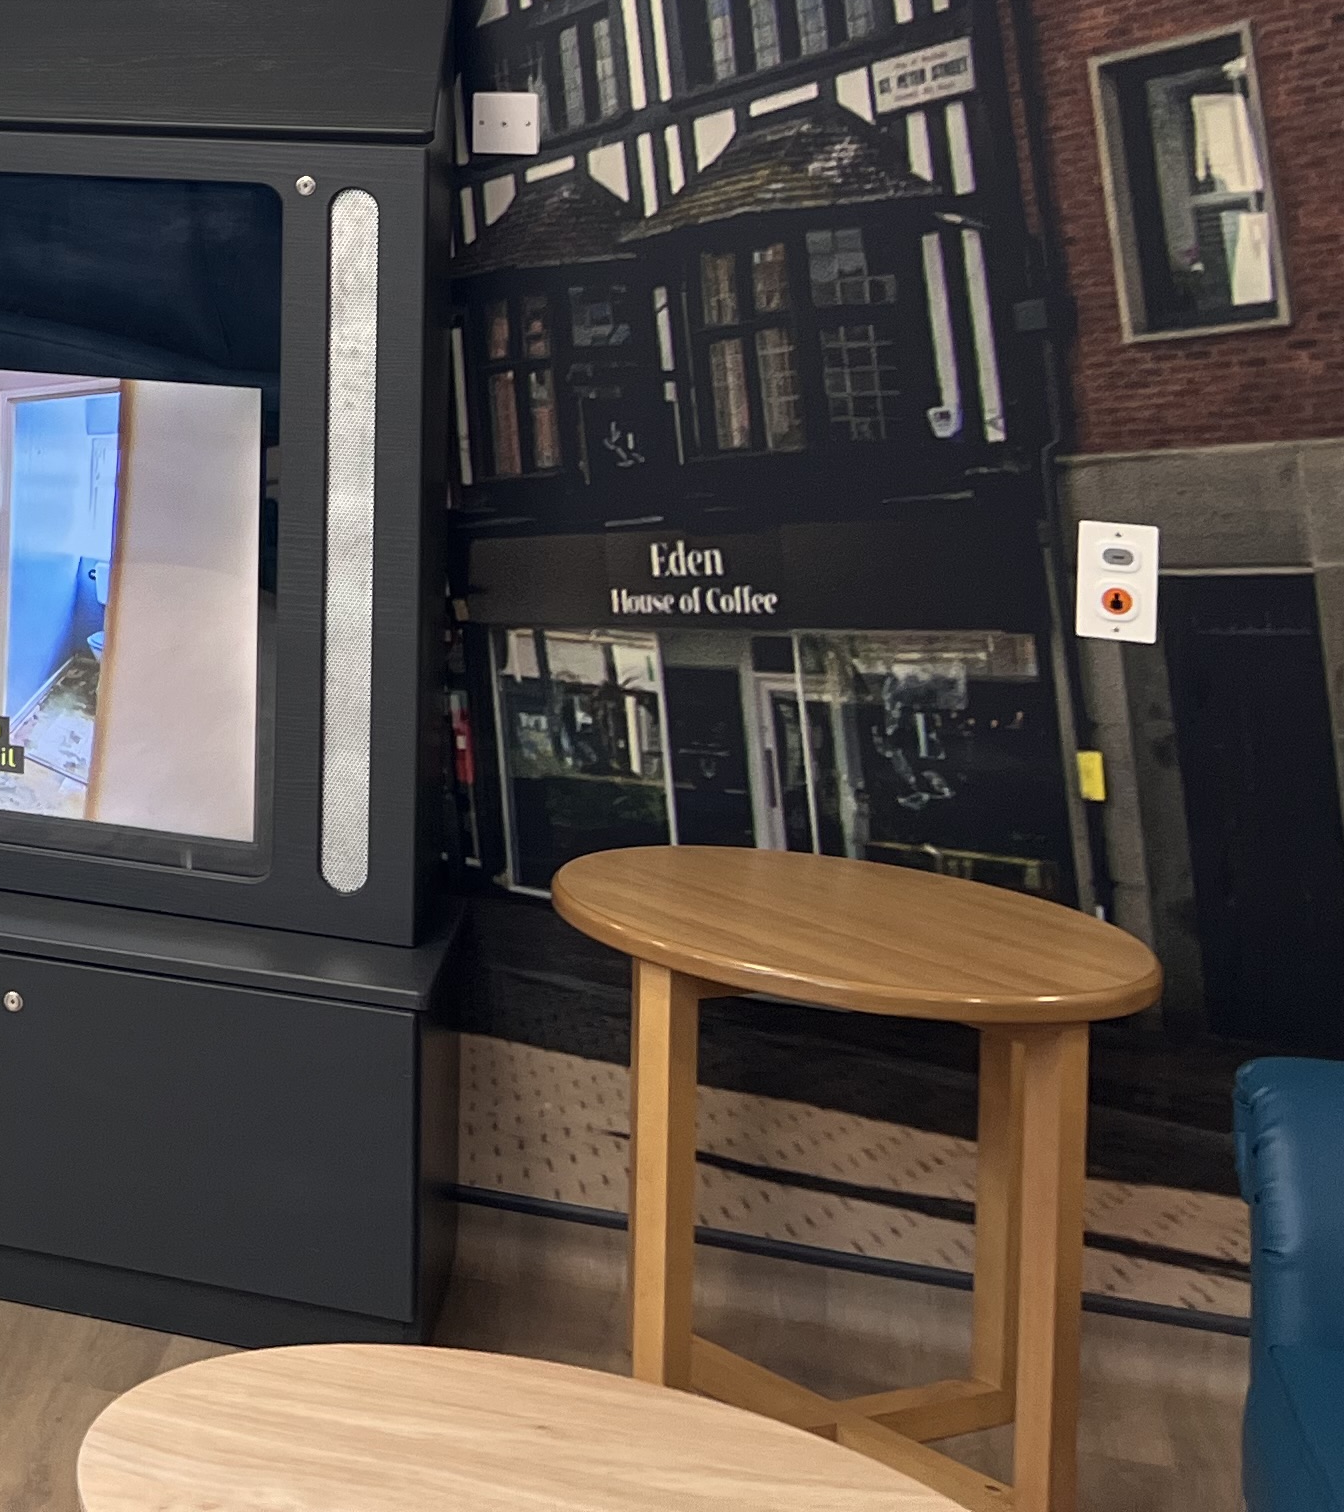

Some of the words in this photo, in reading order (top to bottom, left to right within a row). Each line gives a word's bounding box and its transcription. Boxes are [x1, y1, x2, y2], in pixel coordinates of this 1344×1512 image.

[649, 540, 724, 578] Eden
[610, 588, 675, 614] House
[678, 586, 701, 614] of
[705, 585, 778, 614] Coffee
